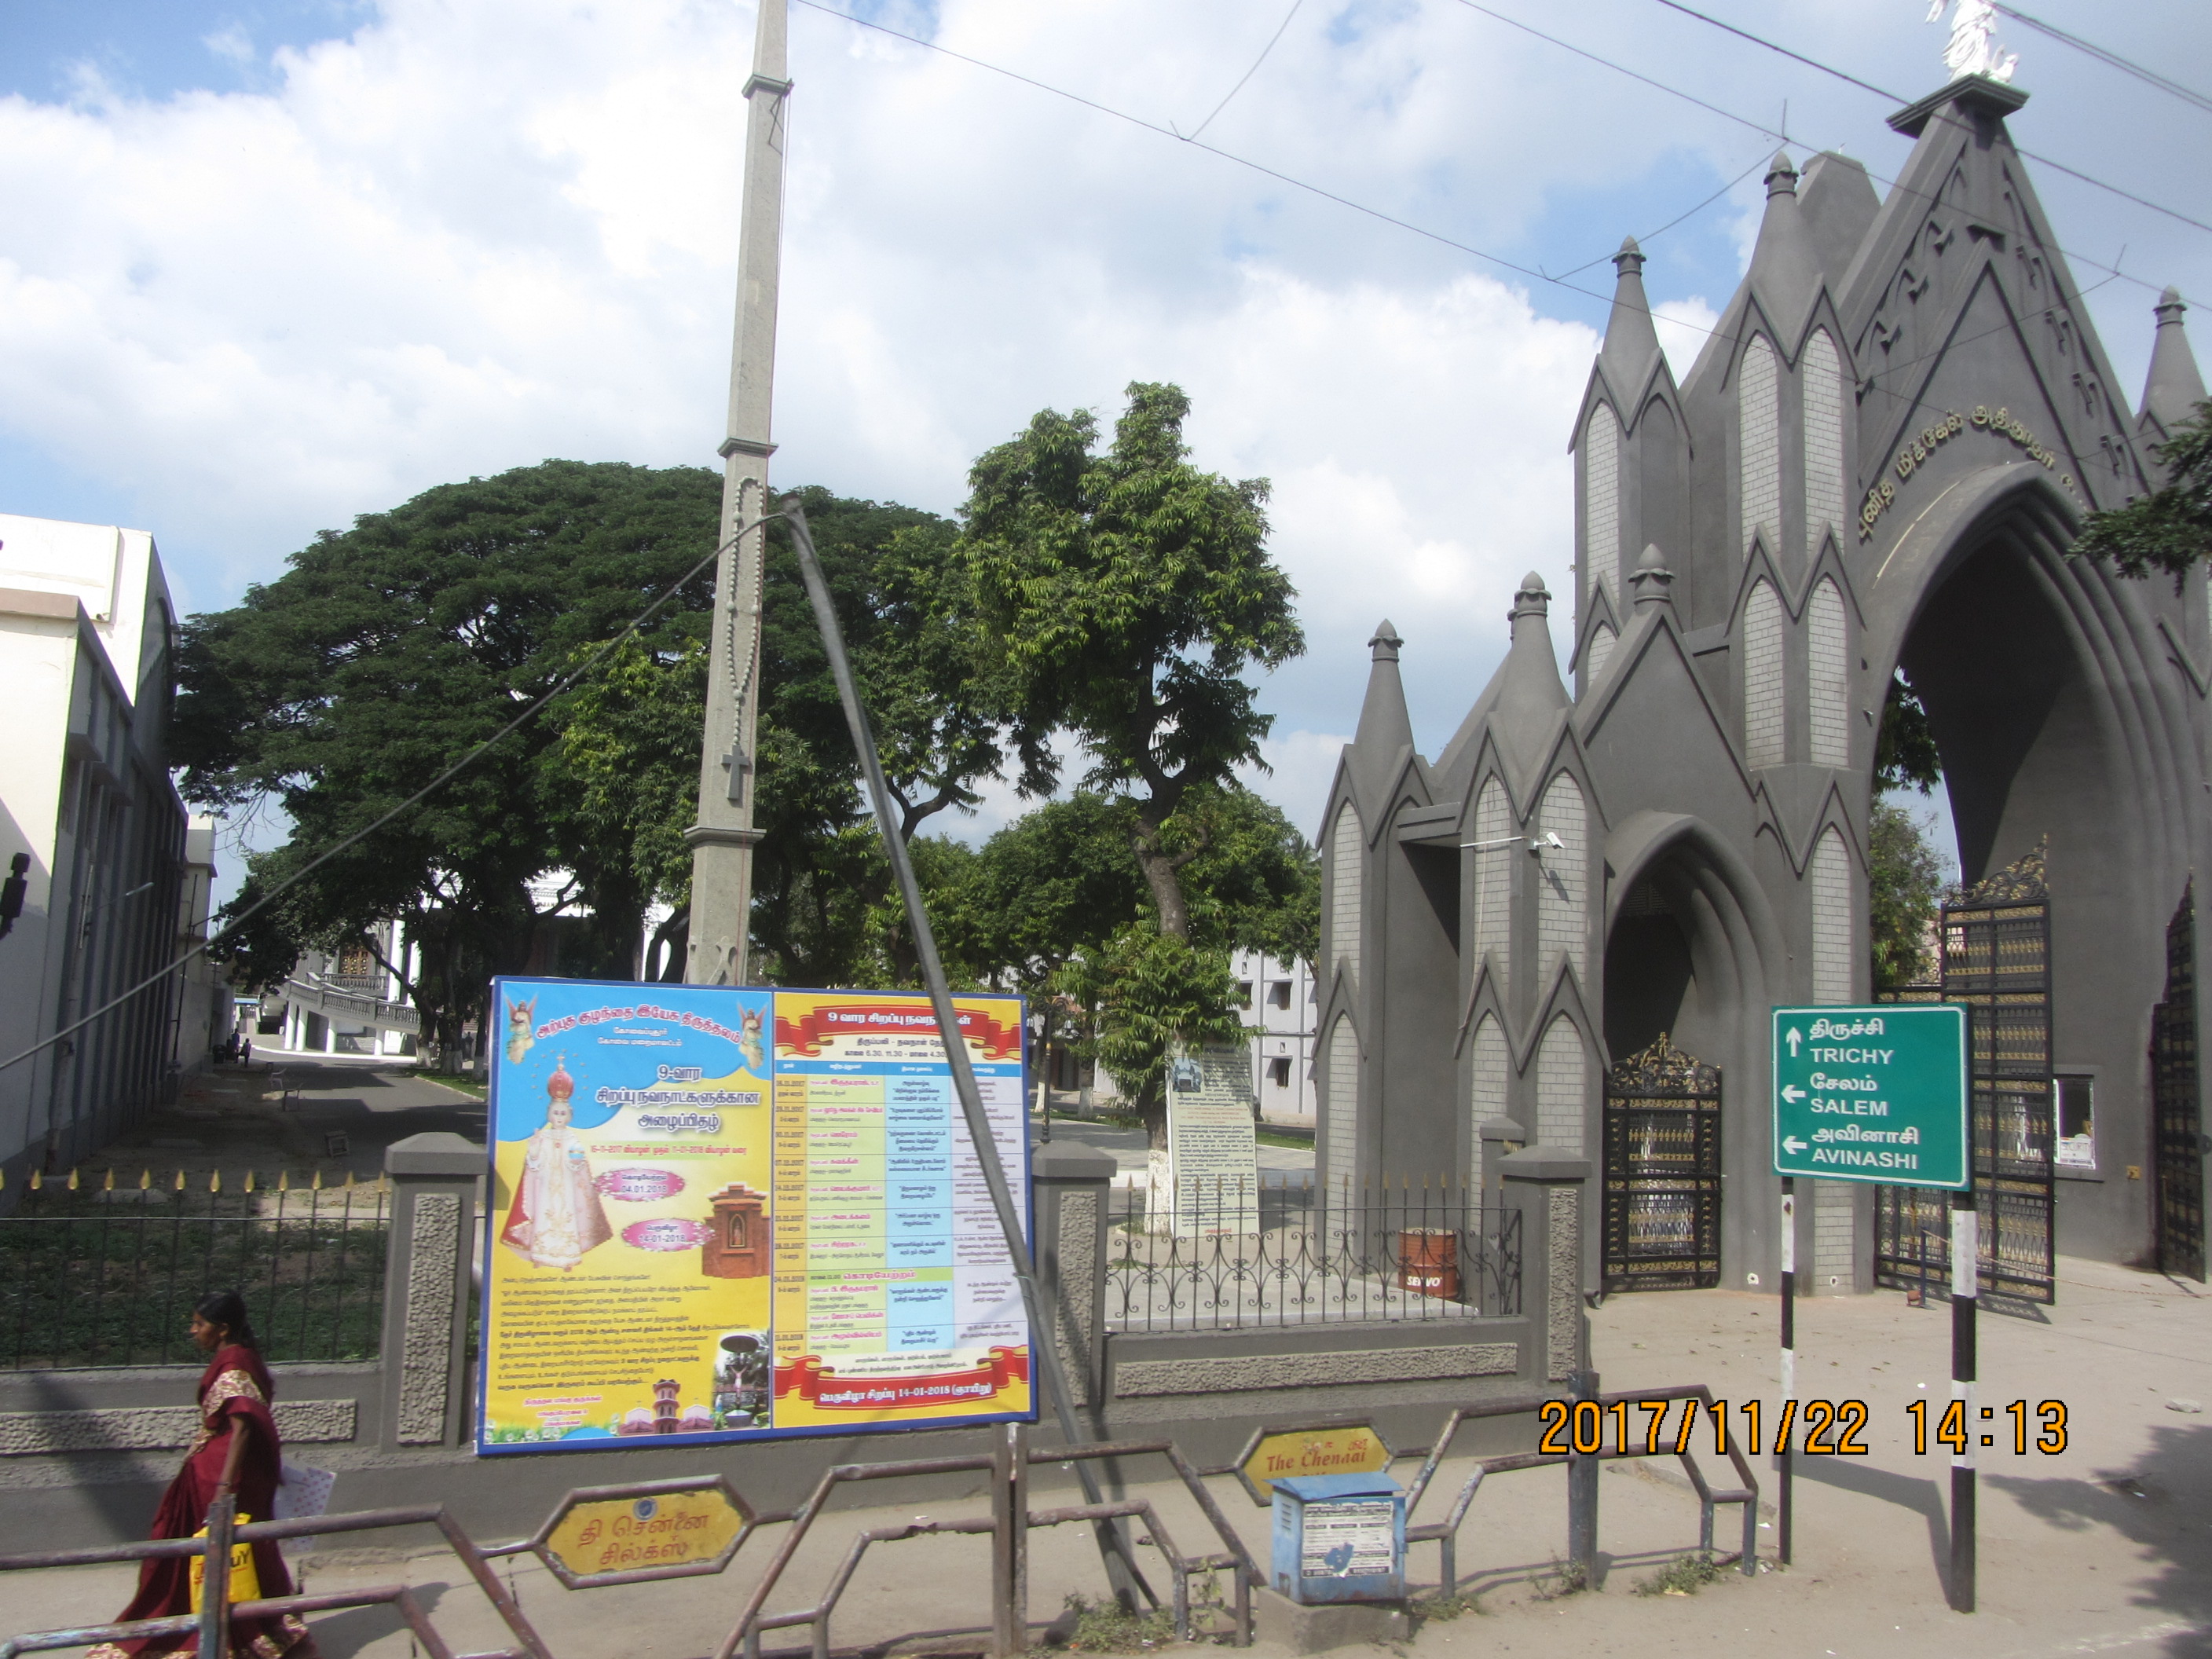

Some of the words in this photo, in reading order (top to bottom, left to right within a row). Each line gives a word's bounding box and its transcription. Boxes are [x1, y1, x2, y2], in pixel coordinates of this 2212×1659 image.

[537, 1016, 576, 1038] அற்புத
[579, 1006, 634, 1024] குழந்தை
[635, 1004, 680, 1021] இயேசு
[681, 1011, 742, 1043] திருத்தலம்
[827, 1012, 838, 1022] 9
[840, 1013, 866, 1024] வார
[868, 1013, 904, 1025] சிறப்பு
[1809, 1018, 1884, 1041] திருச்சி
[1810, 1048, 1894, 1064] TRICHY
[657, 1065, 701, 1081] 9-வார
[1810, 1072, 1878, 1092] சேலம்
[596, 1087, 635, 1107] சிறப்பு
[636, 1089, 760, 1105] நவநாட்களுக்கான
[1811, 1098, 1888, 1116] SALEM
[638, 1112, 720, 1132] அழைப்பிதழ்
[1811, 1124, 1919, 1144] அவினாசி
[1811, 1148, 1918, 1169] AVINASHI
[621, 1185, 668, 1193] 04.01.2018
[639, 1233, 686, 1243] 14-01-2018
[819, 1390, 866, 1403] பெருவிழா
[866, 1387, 895, 1401] சிறப்பு
[898, 1386, 950, 1398] 14-01-2018
[1266, 1454, 1295, 1473] The
[1301, 1451, 1367, 1468] Chennai
[577, 1518, 603, 1549] தி
[612, 1511, 709, 1537] சென்னை
[599, 1535, 690, 1565] சில்க்ஸ்
